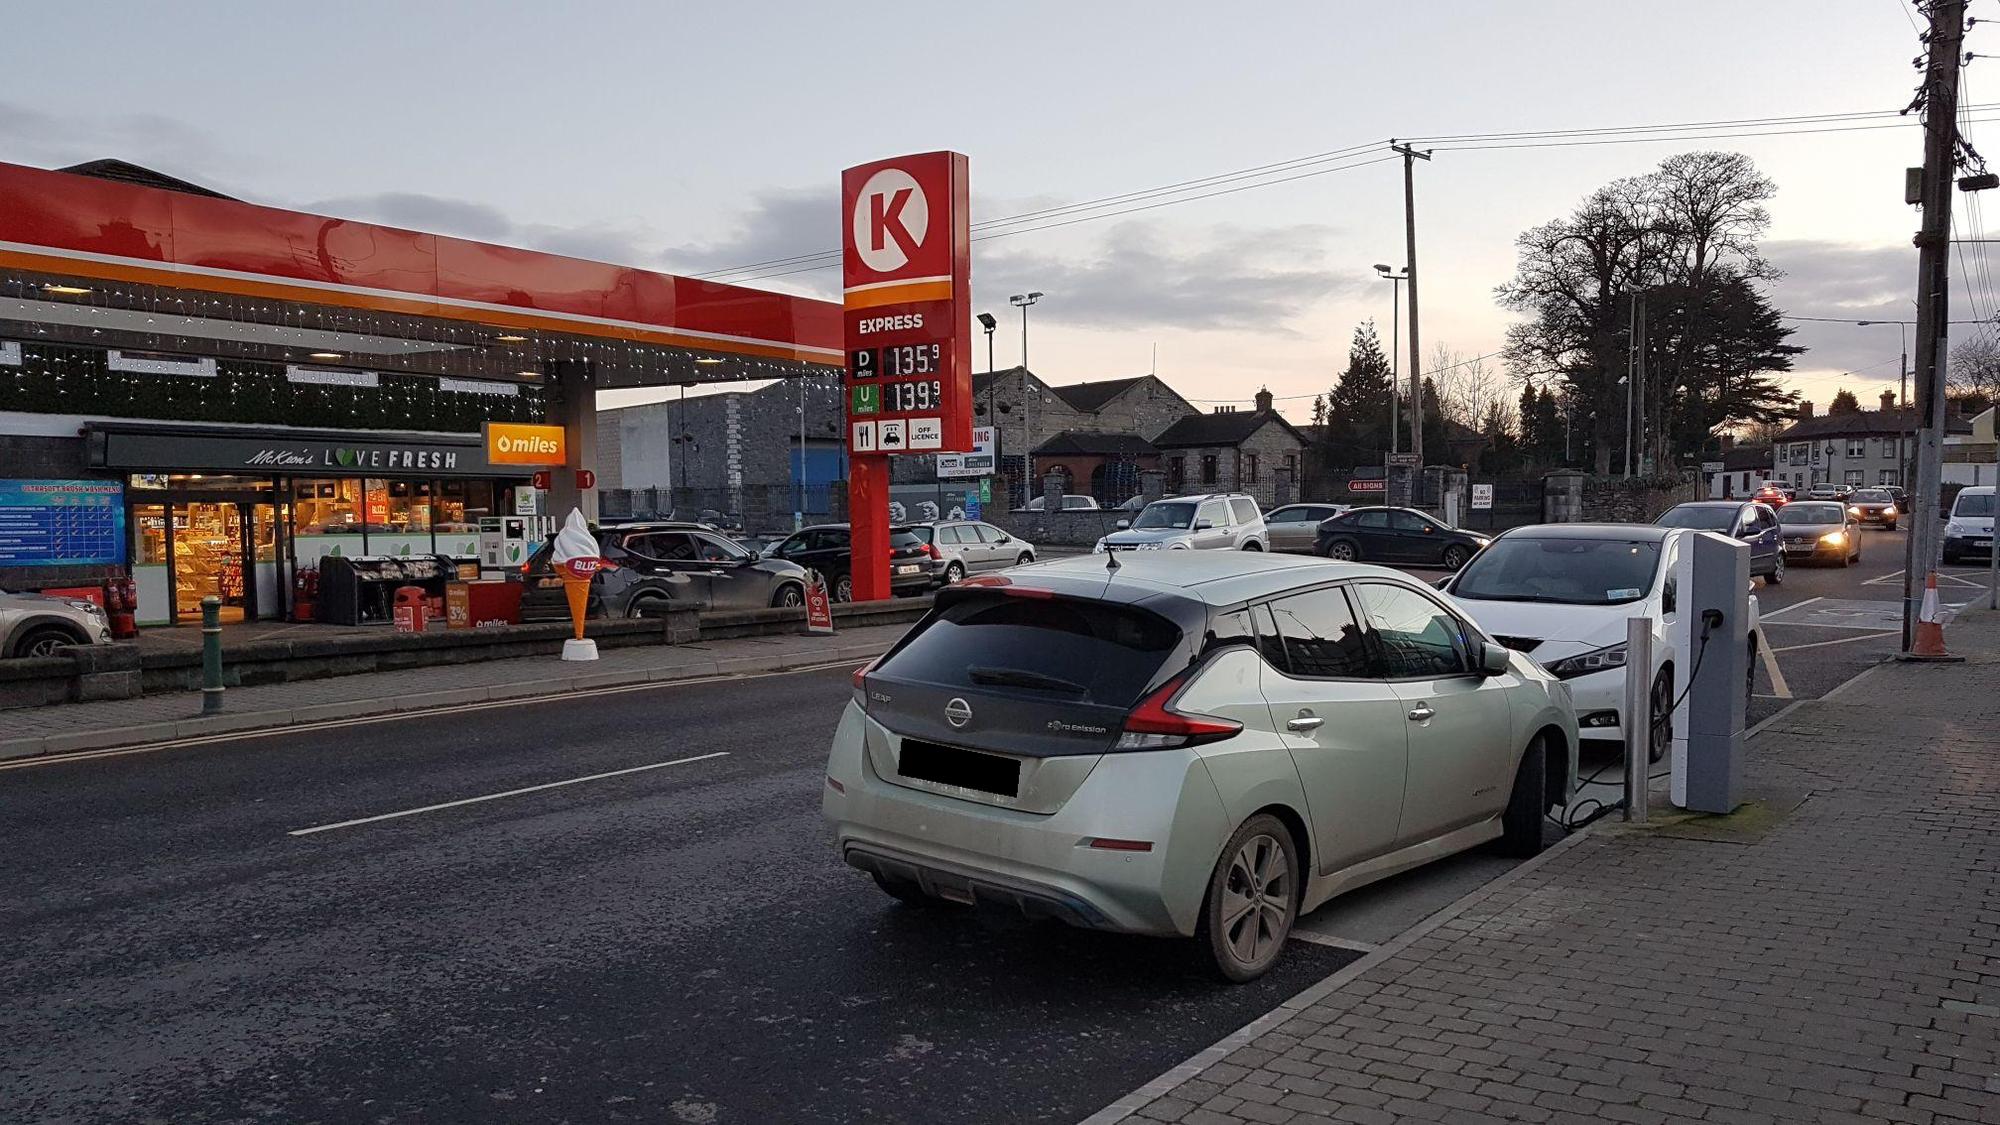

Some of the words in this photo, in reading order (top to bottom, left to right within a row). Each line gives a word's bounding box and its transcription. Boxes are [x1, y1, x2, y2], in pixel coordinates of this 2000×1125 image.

[871, 187, 920, 262] K
[859, 313, 924, 334] EXPRESS
[859, 350, 870, 367] D
[857, 369, 873, 377] miles
[860, 386, 870, 402] U
[857, 405, 873, 413] miles
[911, 433, 939, 441] LICENCE
[974, 430, 990, 443] ING
[511, 436, 558, 454] miles
[388, 450, 457, 469] FRESH
[535, 473, 542, 487] 2
[585, 472, 591, 487] 1
[1363, 481, 1383, 490] SIGNS
[574, 560, 598, 571] BLIZ
[450, 606, 467, 620] 3%
[483, 618, 508, 628] miles
